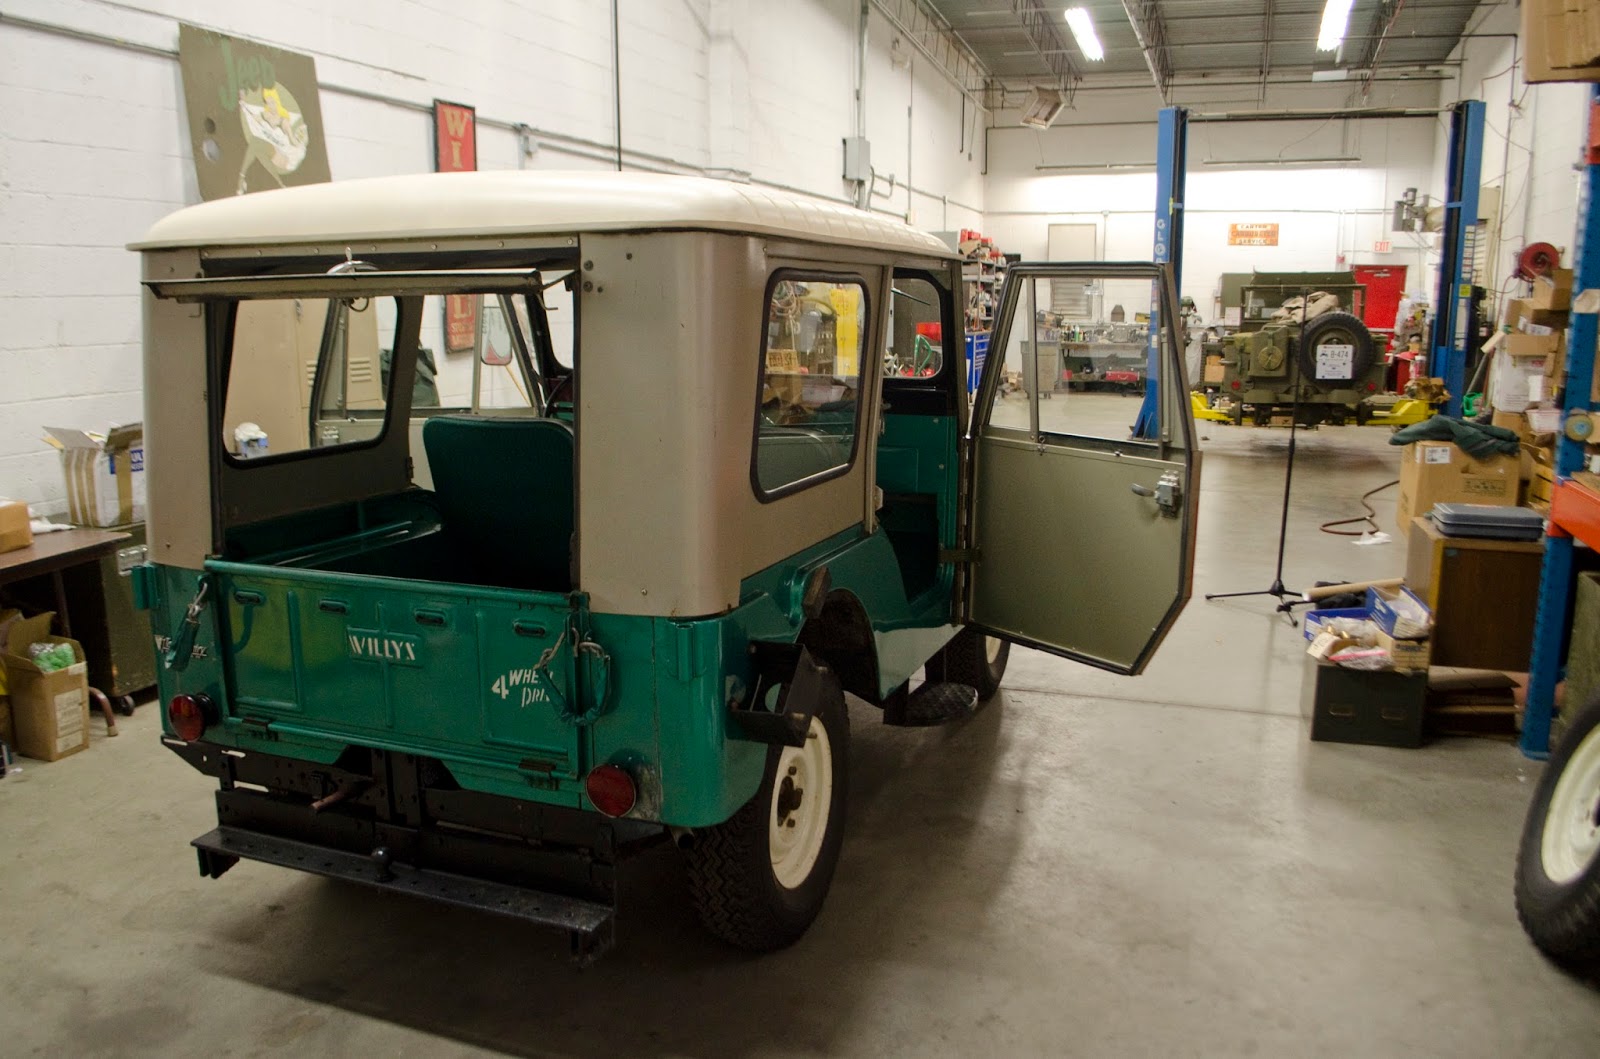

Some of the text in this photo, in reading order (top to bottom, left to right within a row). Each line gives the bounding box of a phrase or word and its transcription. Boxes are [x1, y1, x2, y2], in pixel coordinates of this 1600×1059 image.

[1374, 241, 1391, 252] EXIT
[348, 634, 416, 661] WILLYS
[491, 674, 509, 700] 4
